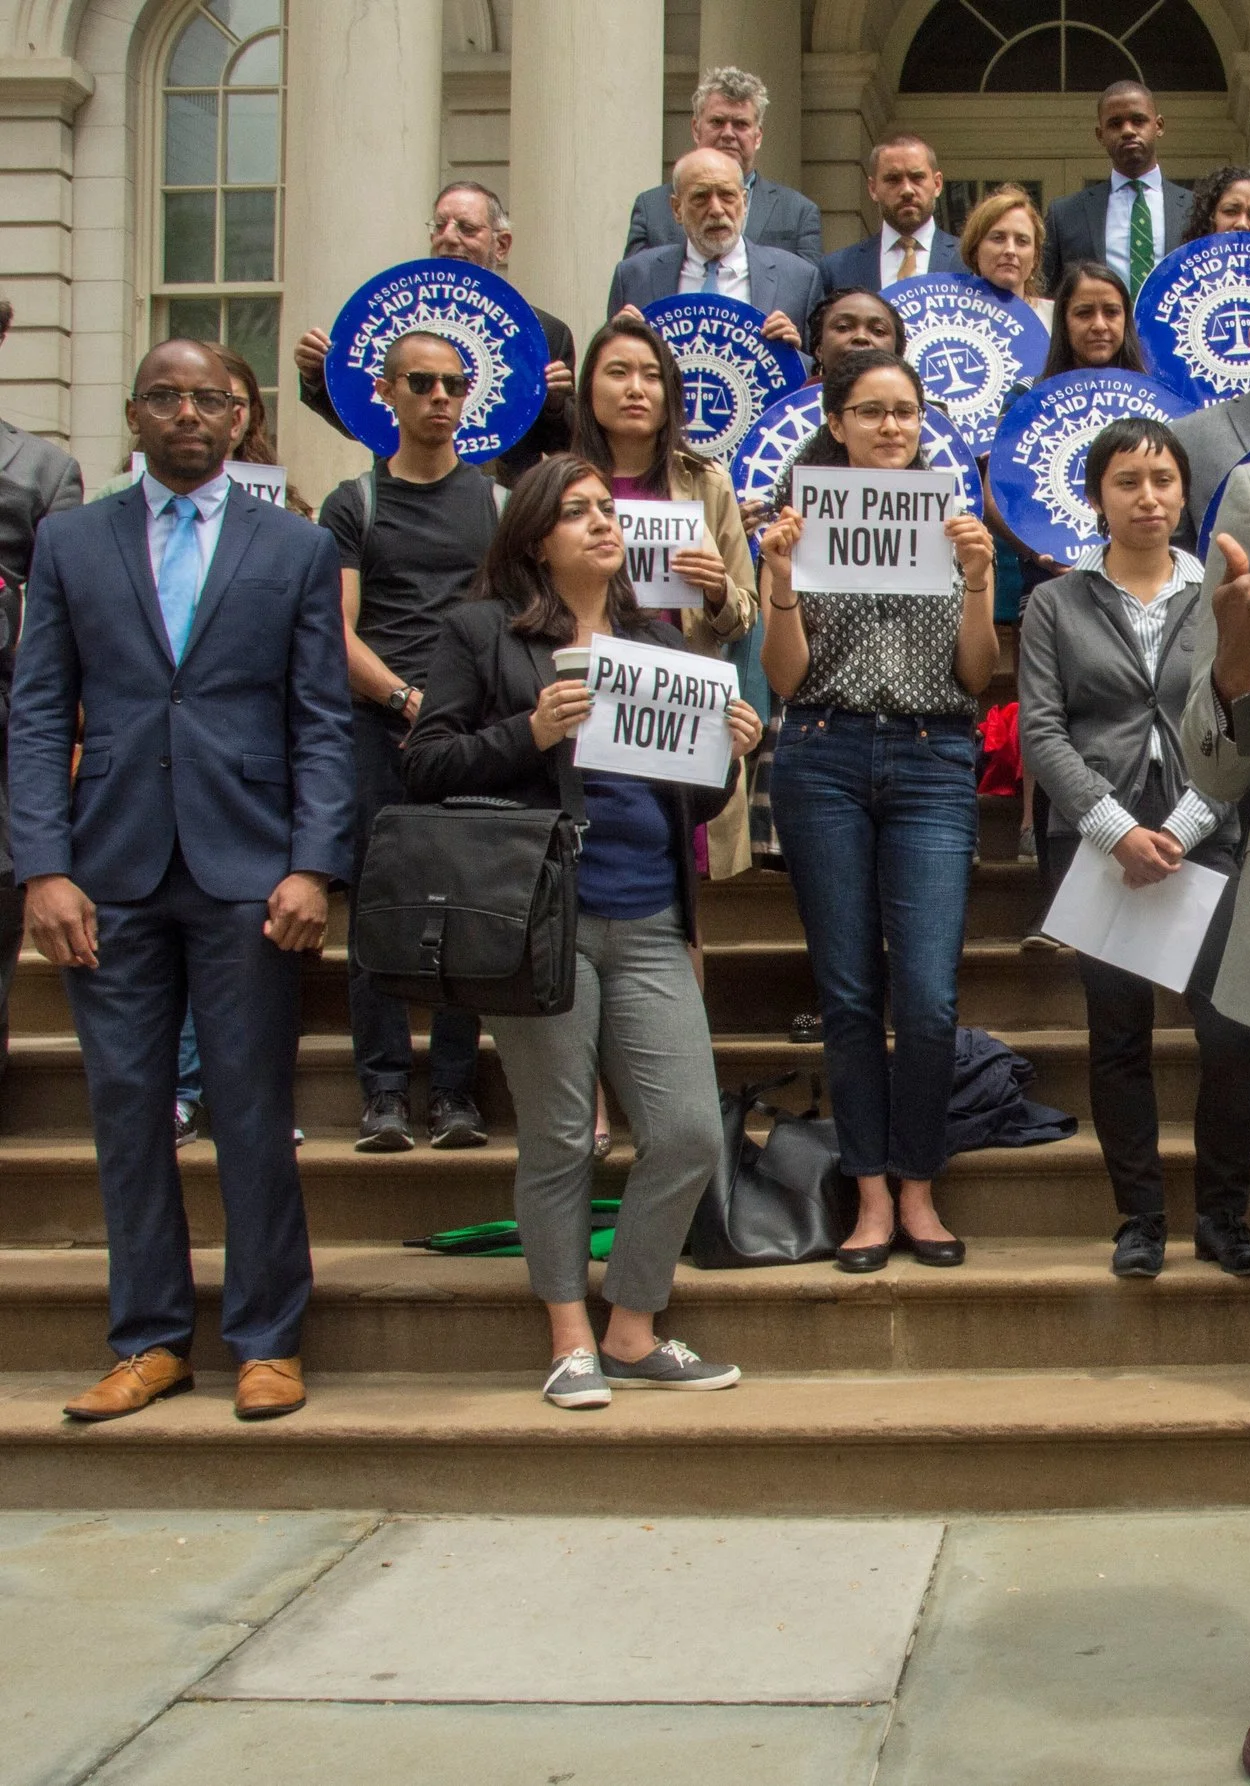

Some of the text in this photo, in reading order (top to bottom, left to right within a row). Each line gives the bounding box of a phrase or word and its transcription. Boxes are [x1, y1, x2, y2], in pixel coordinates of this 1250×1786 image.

[367, 271, 481, 309] ASSOCIATION OF
[890, 284, 982, 307] SOCIATION OF
[1154, 277, 1194, 323] LEGAL
[1192, 258, 1222, 281] AID
[347, 284, 520, 369] LEGAL AID ATTORNEYS
[650, 305, 762, 334] ASSOCIATION OF
[926, 294, 1025, 336] ATTORNEYS
[662, 318, 787, 389] AID ATTORNEYS
[1040, 380, 1157, 410] ASSOCIATION OF
[456, 434, 500, 455] 2325
[1012, 414, 1056, 465] LEGAL
[1054, 395, 1088, 419] AID
[1091, 392, 1174, 425] ATTORN
[802, 485, 950, 521] PAY PARITY
[619, 514, 698, 541] PARITY
[594, 656, 733, 713] PAY PARITY
